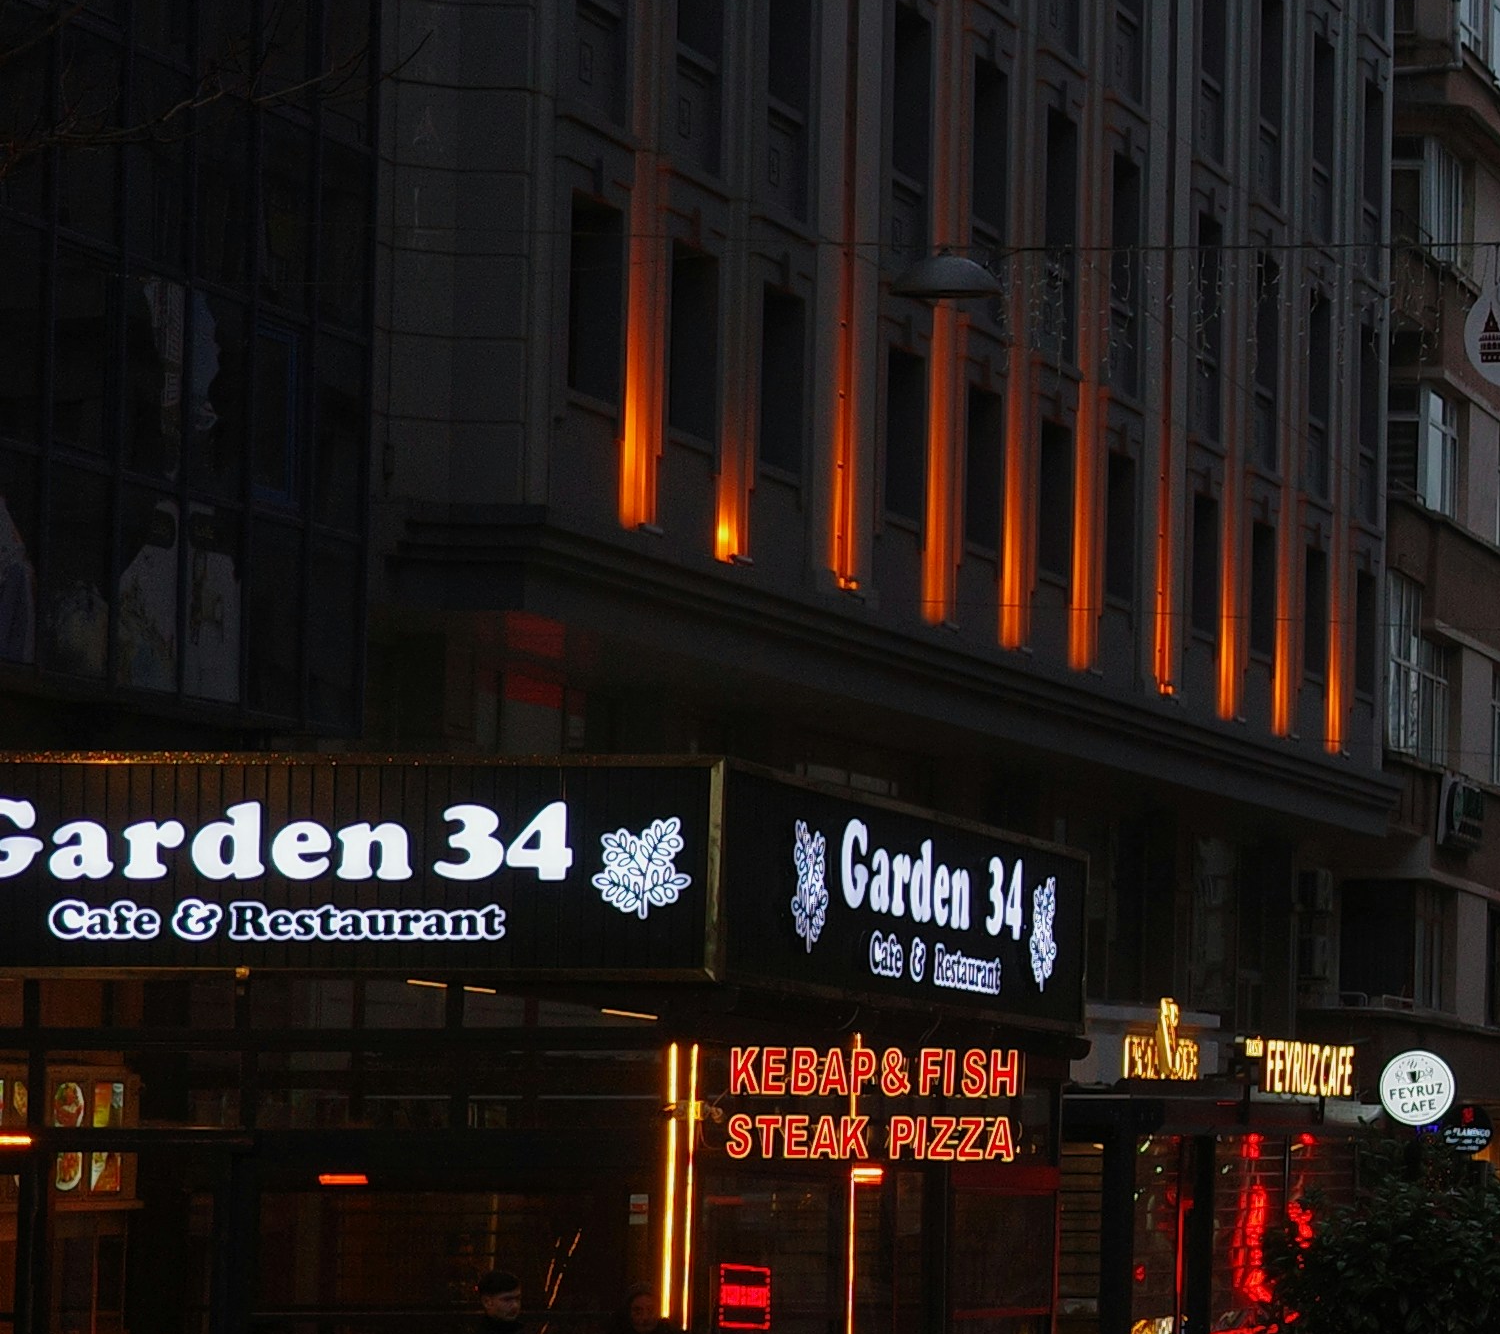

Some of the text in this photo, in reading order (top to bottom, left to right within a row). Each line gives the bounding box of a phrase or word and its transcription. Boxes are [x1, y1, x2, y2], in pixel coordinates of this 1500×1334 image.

[0, 796, 574, 882] Garden 34
[841, 817, 1024, 941] Garden 34
[48, 897, 507, 942] Cafe & Restaurant
[869, 928, 1001, 996] Cafe & Restaurant
[729, 1045, 876, 1097] KEBAP
[918, 1047, 1019, 1098] FISH
[1266, 1039, 1355, 1097] FEYRUZ CAFE
[1389, 1082, 1444, 1100] FEYRUZ
[1400, 1099, 1437, 1114] CAFE
[726, 1113, 1014, 1162] STEAK PIZZA
